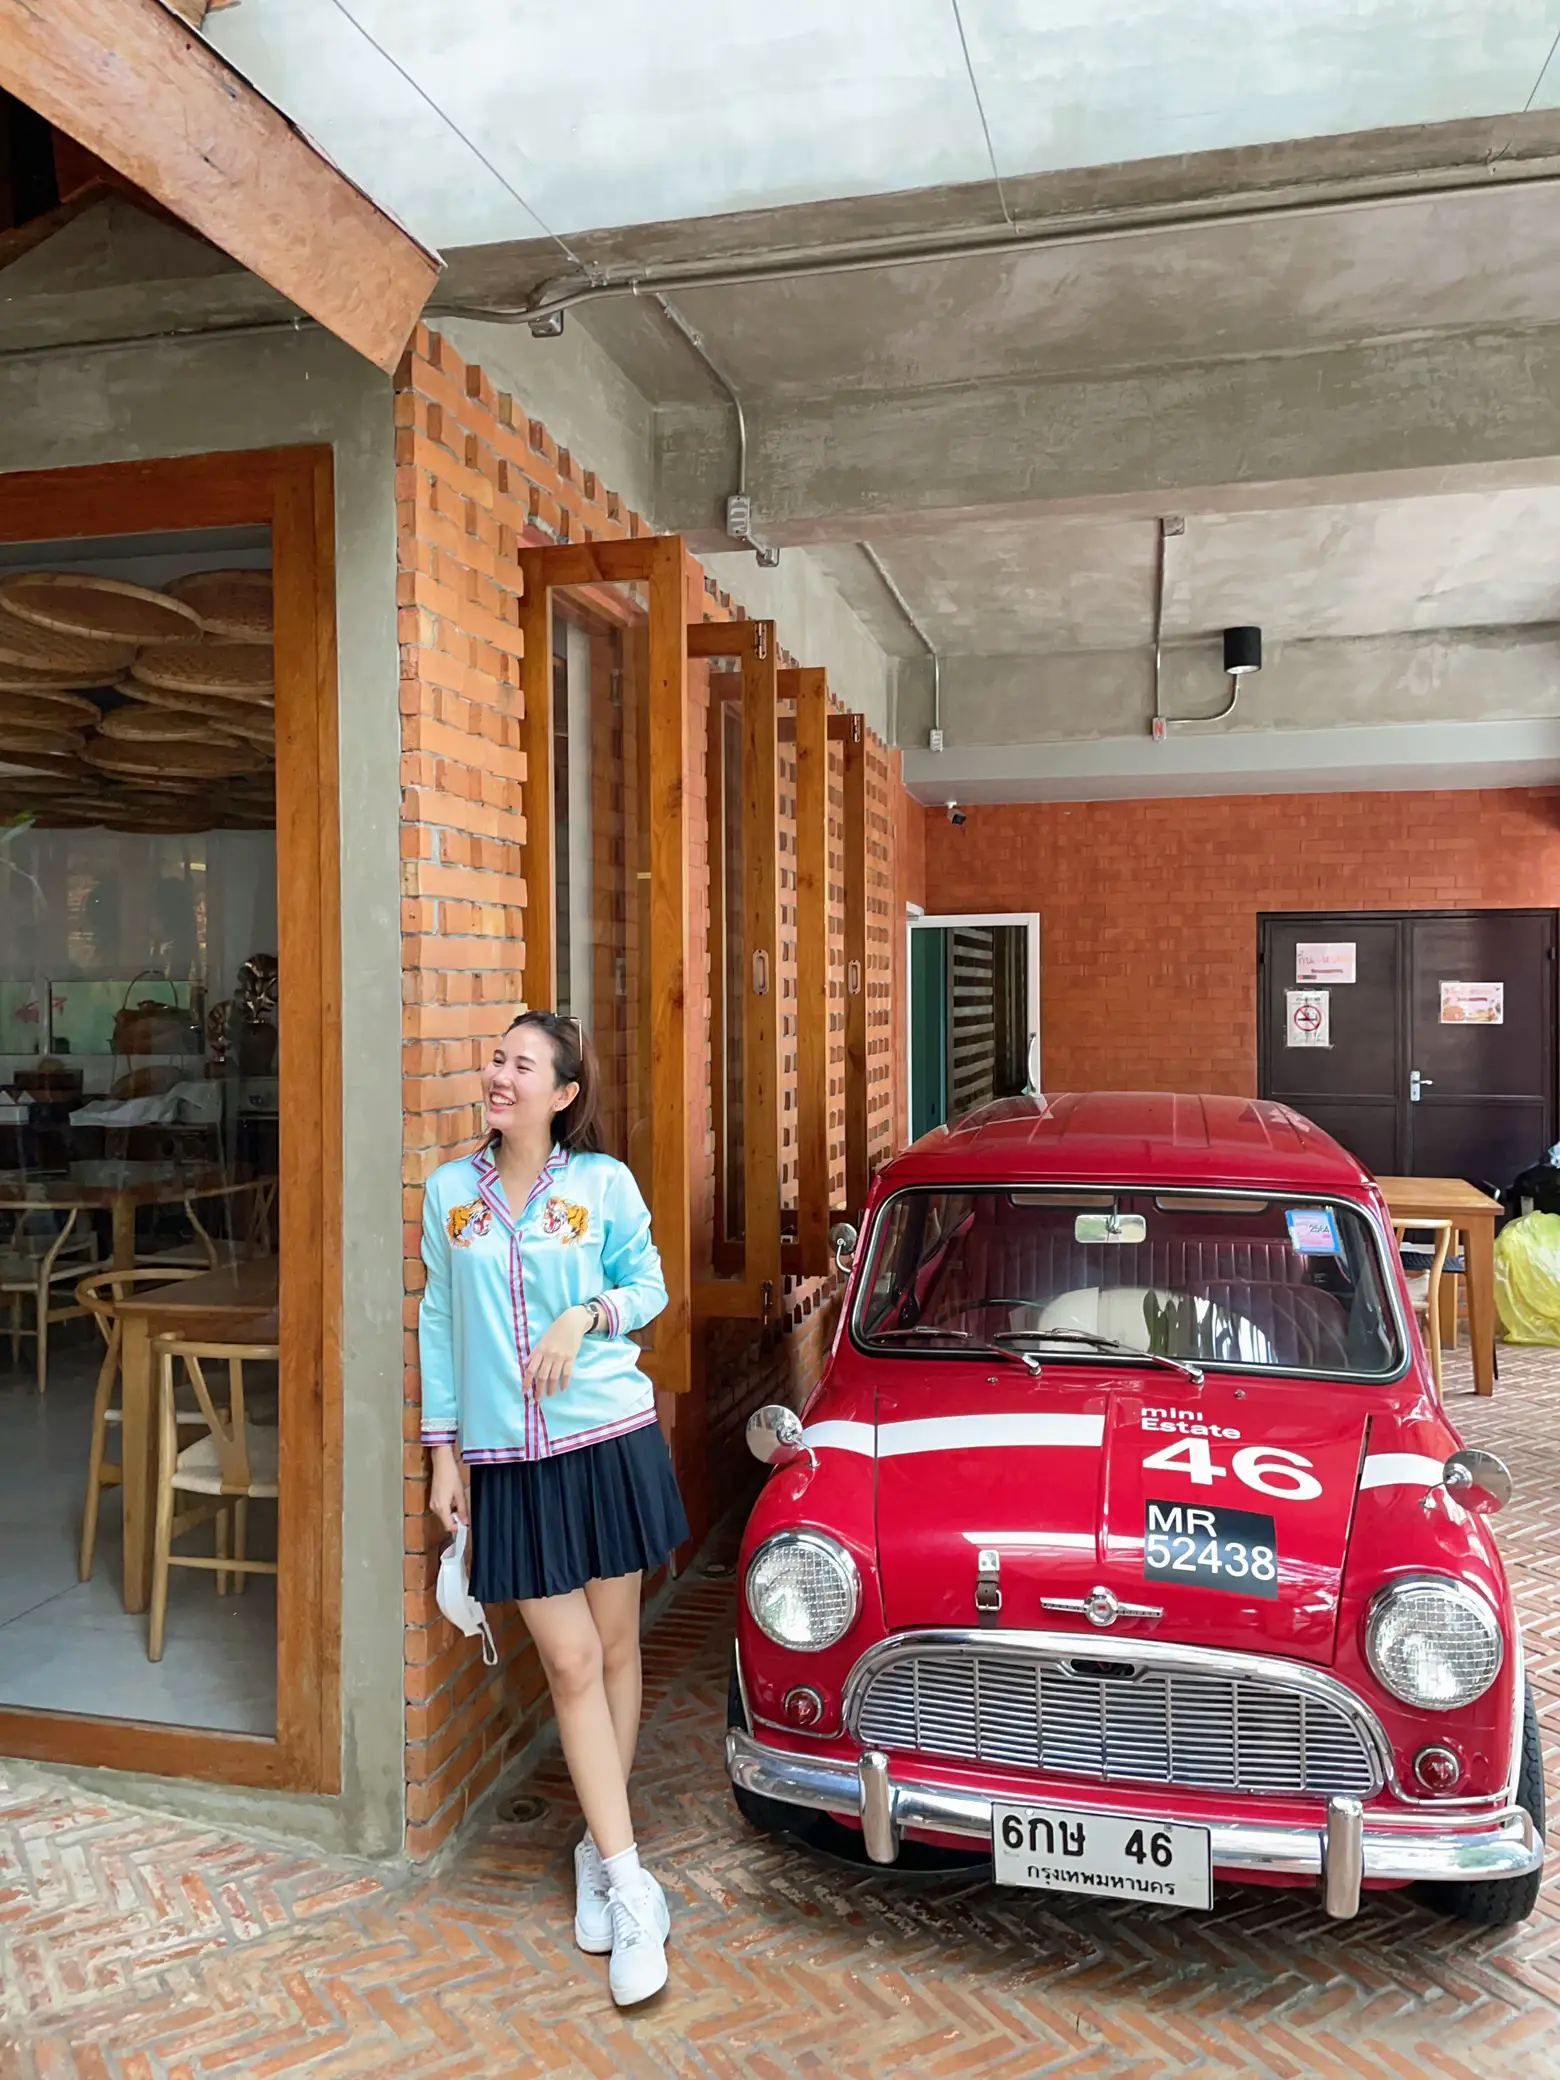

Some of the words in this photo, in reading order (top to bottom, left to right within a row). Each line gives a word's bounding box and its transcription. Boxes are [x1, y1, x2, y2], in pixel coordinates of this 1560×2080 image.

[1141, 1407, 1203, 1422] mini
[1141, 1417, 1241, 1440] Estate
[1142, 1437, 1323, 1501] 46
[1148, 1504, 1217, 1537] MR
[1146, 1534, 1276, 1581] 52438
[1002, 1814, 1086, 1857] 6กษ
[1124, 1829, 1173, 1868] 46
[1027, 1864, 1176, 1896] กรุงเทพมหานคร
